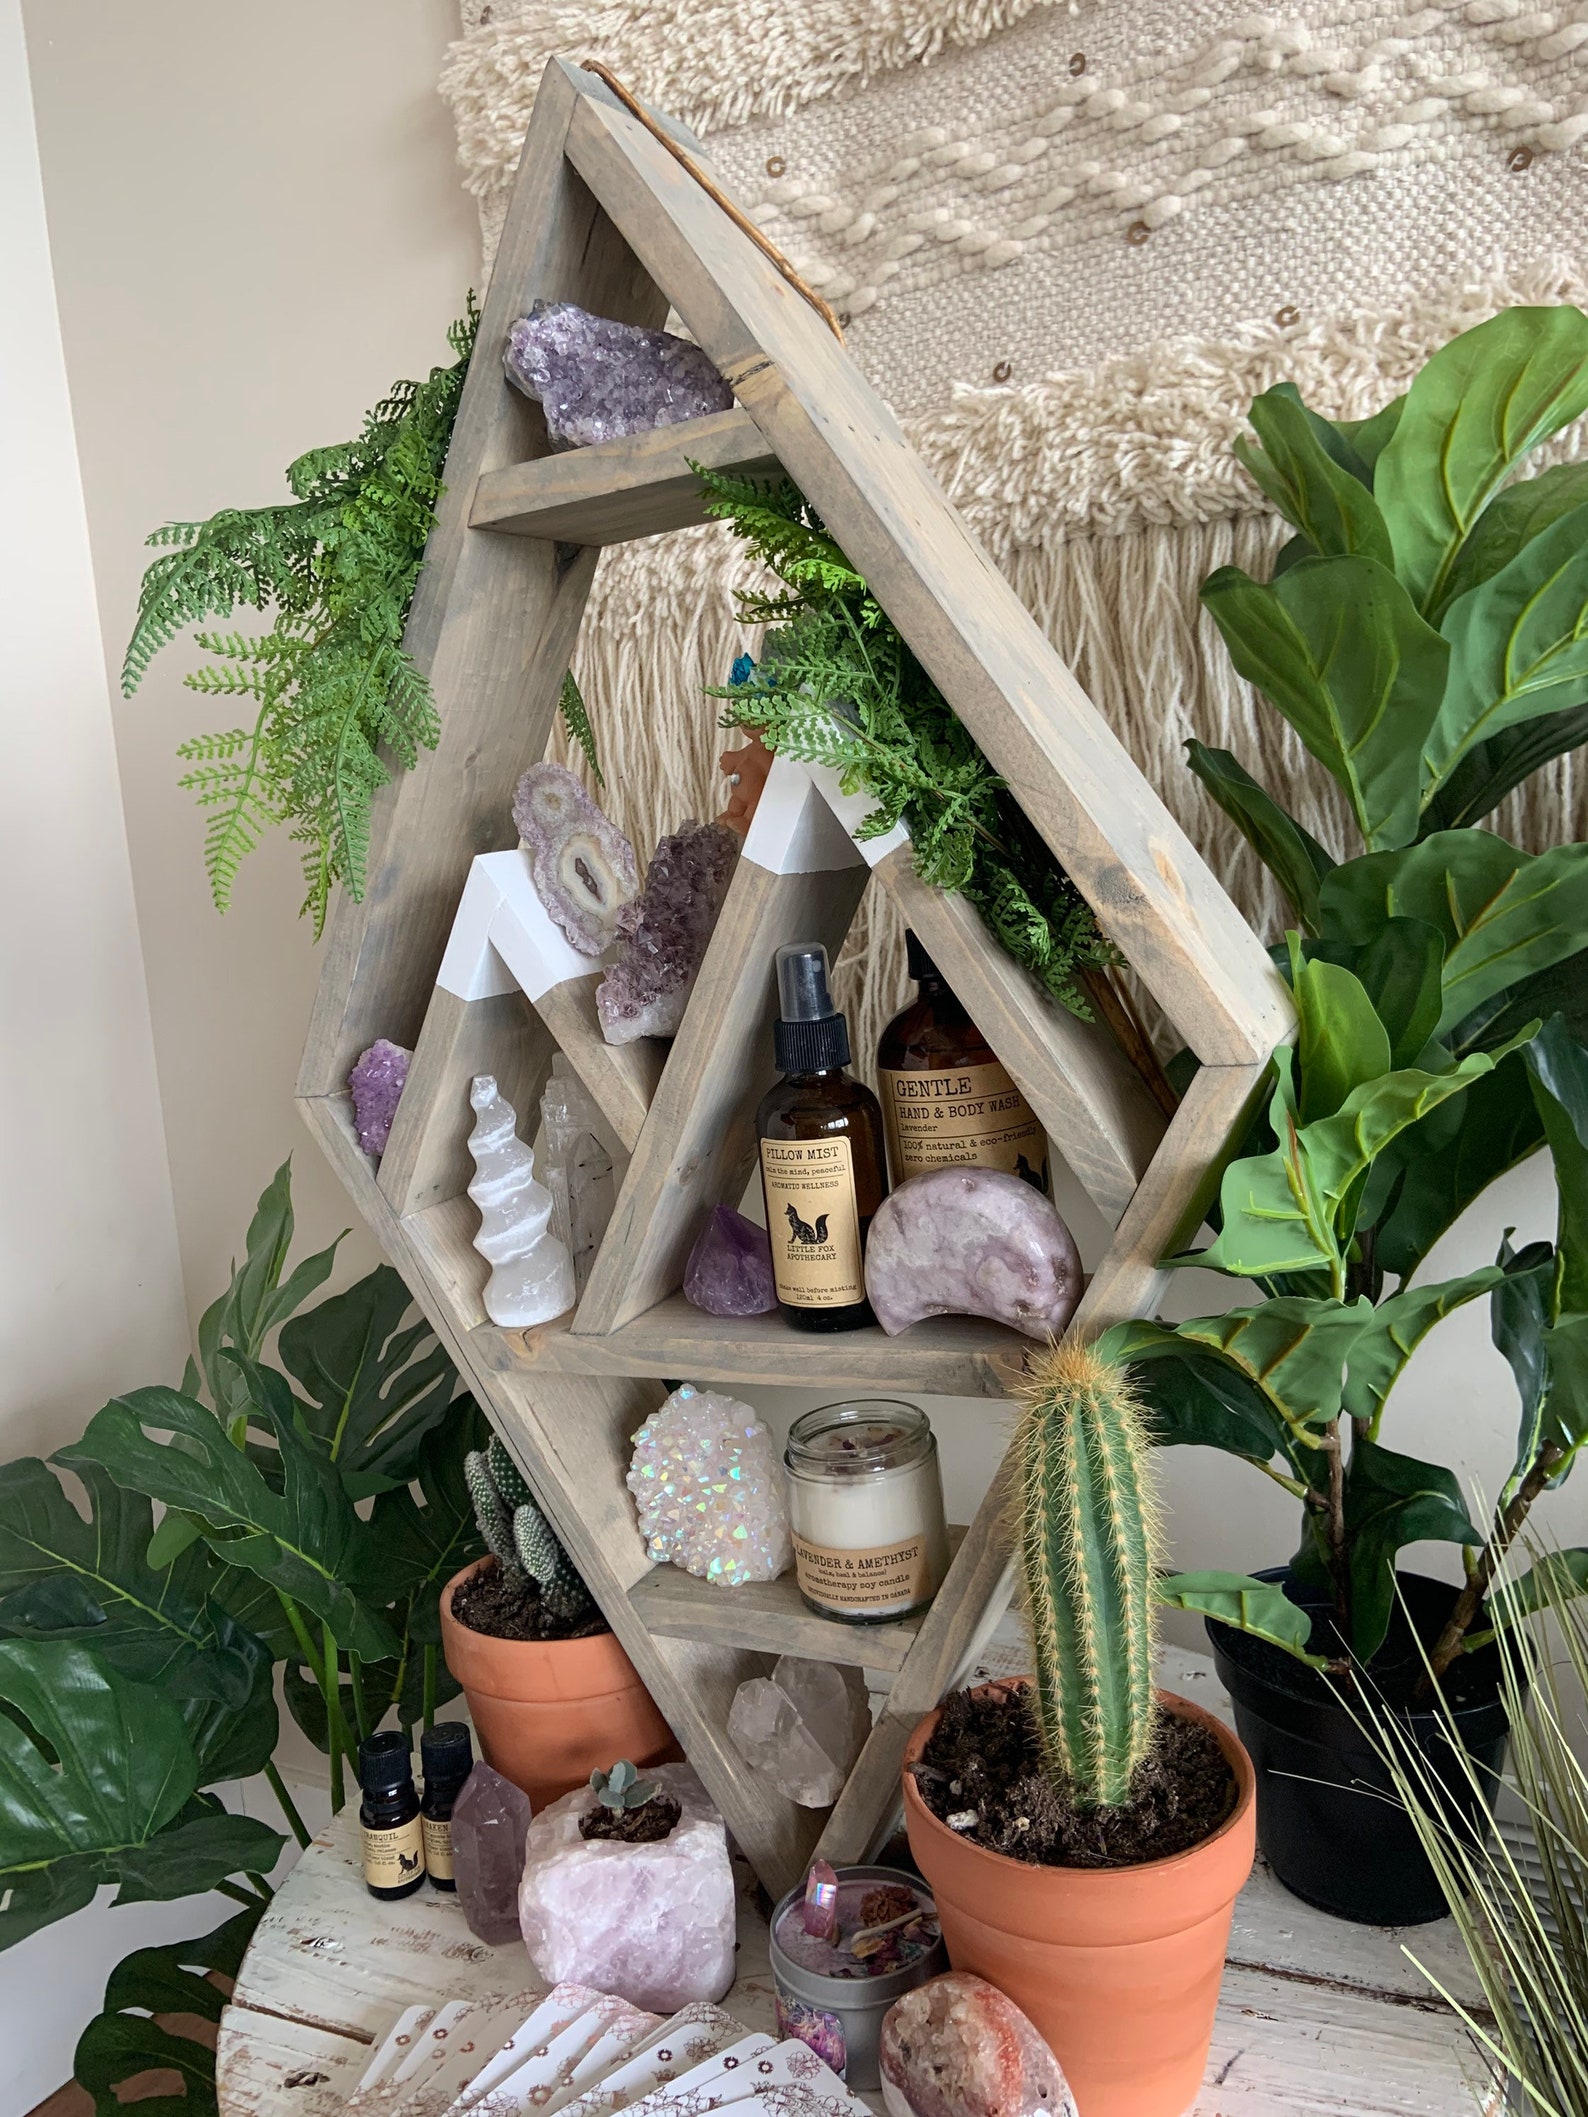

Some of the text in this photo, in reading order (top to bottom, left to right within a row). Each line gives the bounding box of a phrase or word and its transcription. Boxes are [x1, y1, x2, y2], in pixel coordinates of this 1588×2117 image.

[896, 1076, 972, 1097] GENTLE
[899, 1095, 1020, 1119] HAND & BODY WASH
[900, 1123, 938, 1132] lavender
[903, 1126, 1037, 1150] 100% natural & eco-friendly
[766, 1146, 839, 1160] PILLOW MIST
[905, 1152, 978, 1163] zero chemicals
[811, 1164, 846, 1176] peaceful
[801, 1180, 839, 1190] WELLNESS
[786, 1244, 835, 1253] LITTLE FOX
[787, 1253, 837, 1261] APOTHECARY
[806, 1285, 828, 1294] before
[796, 1543, 919, 1570] LAVENDER & AMETHYST
[805, 1572, 910, 1591] aromatherapy soy candle
